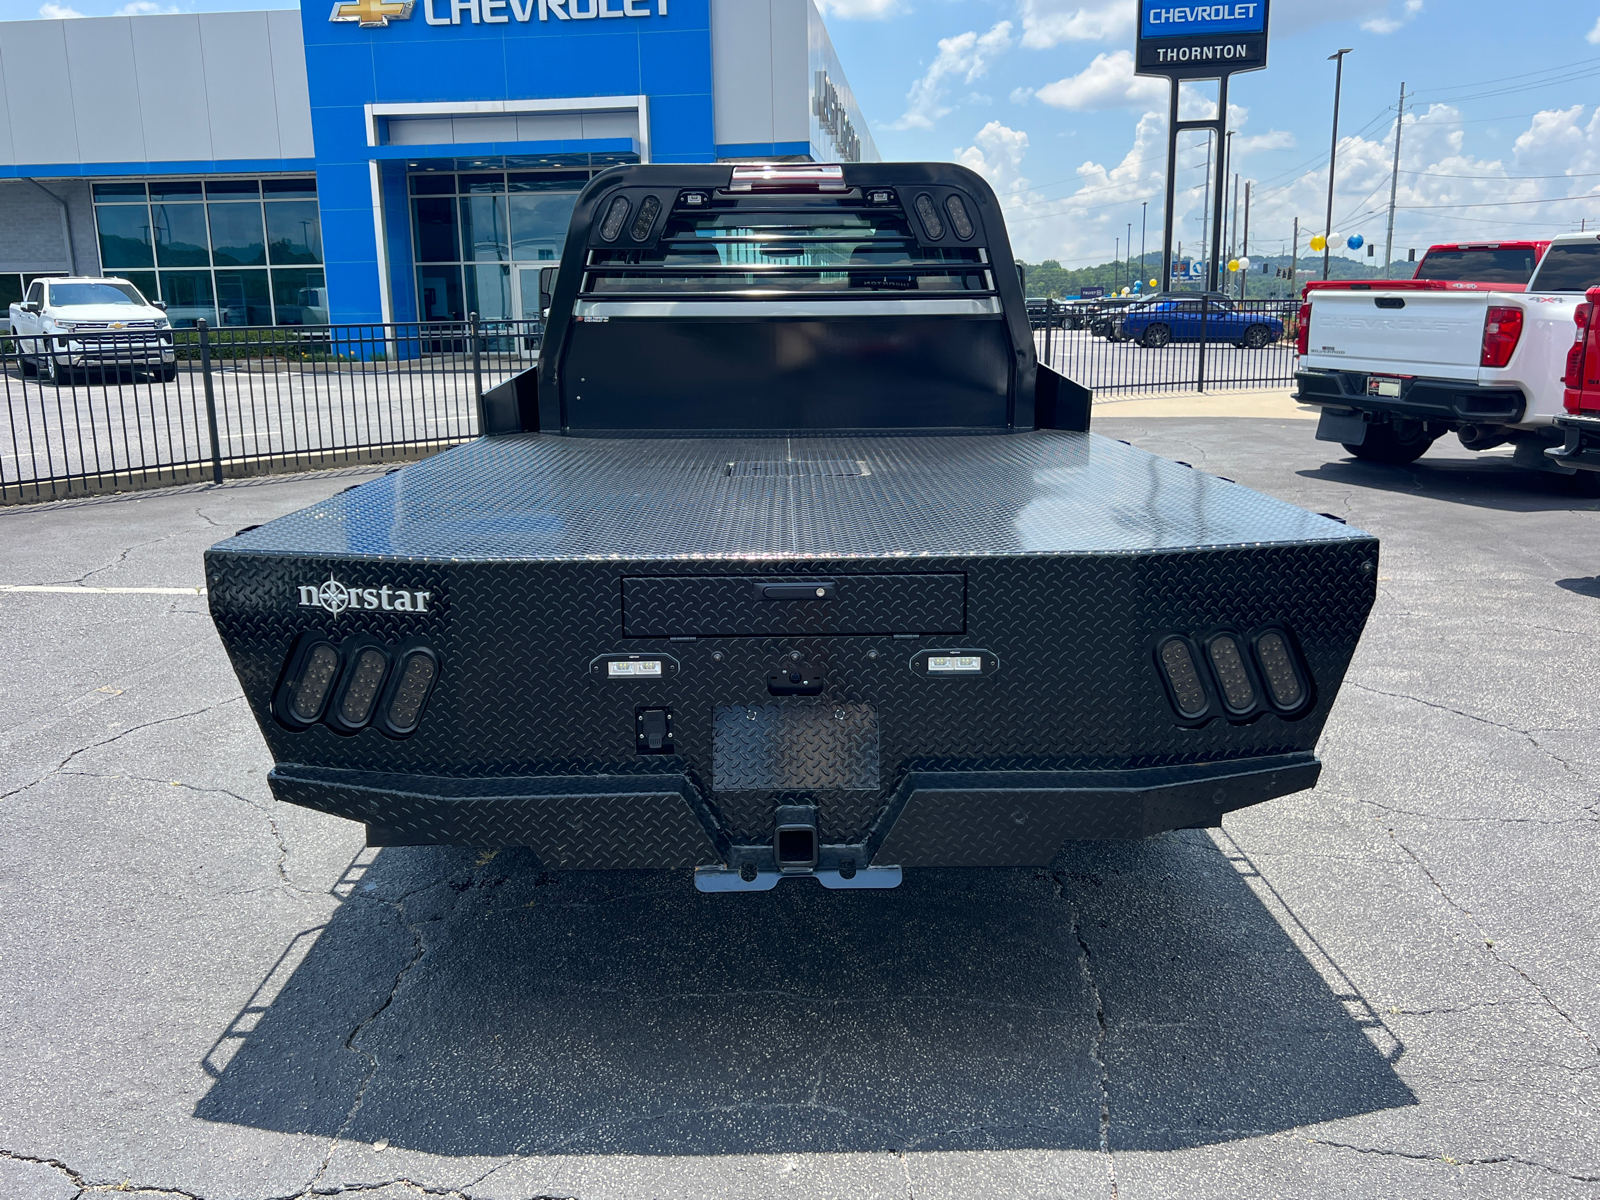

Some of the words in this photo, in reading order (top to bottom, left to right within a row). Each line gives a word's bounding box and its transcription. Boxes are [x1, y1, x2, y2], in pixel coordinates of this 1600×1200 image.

[1149, 3, 1257, 24] CHEVROLET
[1157, 44, 1246, 62] THORNTON
[1319, 316, 1470, 333] CHEVROLET
